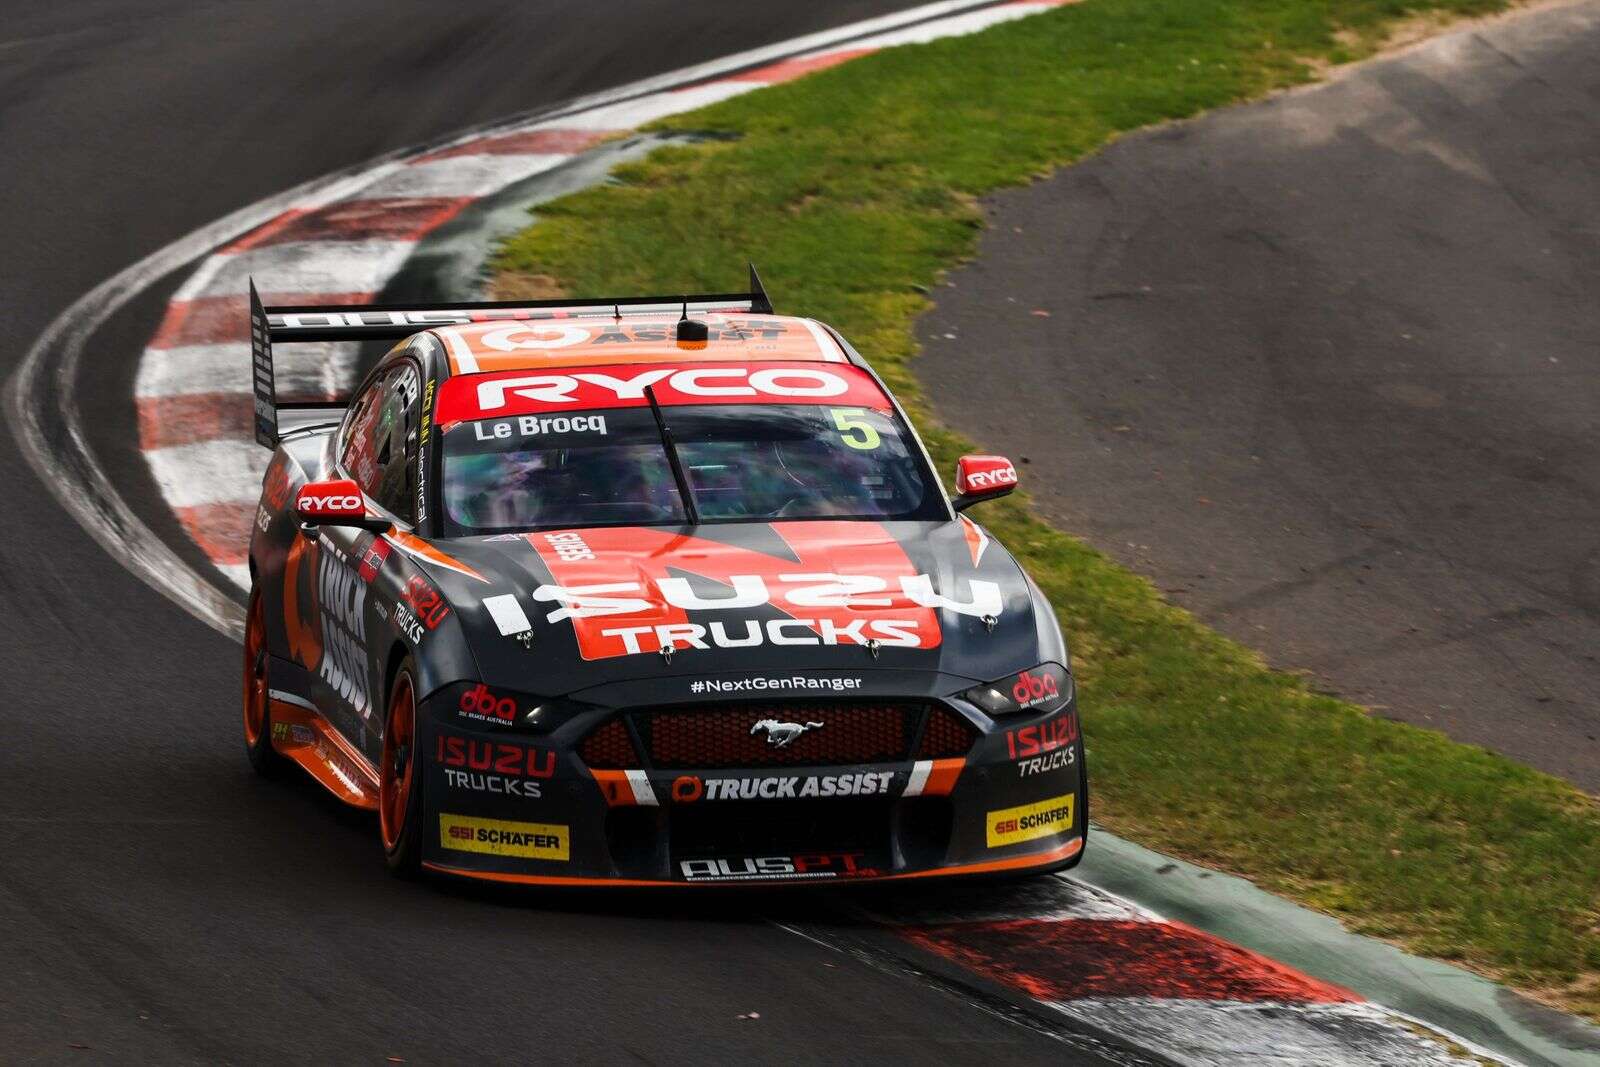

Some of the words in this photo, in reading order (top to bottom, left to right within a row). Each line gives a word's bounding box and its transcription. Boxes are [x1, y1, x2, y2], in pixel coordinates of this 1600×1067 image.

[476, 368, 849, 411] RYCO
[473, 421, 513, 441] Le
[517, 414, 608, 437] Brocq
[830, 408, 881, 450] 5
[966, 467, 1018, 488] RYCO
[297, 495, 362, 512] RYCO
[482, 572, 1004, 637] ISUZU
[393, 601, 425, 645] TRUCKS
[601, 618, 922, 656] TRUCKS
[690, 676, 863, 694] #NextGenRanger
[1012, 671, 1057, 704] dba
[459, 683, 517, 720] dba
[1007, 710, 1077, 761] ISUZU
[436, 735, 556, 779] ISUZU
[1018, 745, 1075, 777] TRUCKS
[445, 769, 542, 799] TRUCKS
[704, 776, 799, 800] TRUCK
[799, 771, 895, 797] ASSIST
[448, 825, 475, 841] SSI
[994, 819, 1018, 835] SSI
